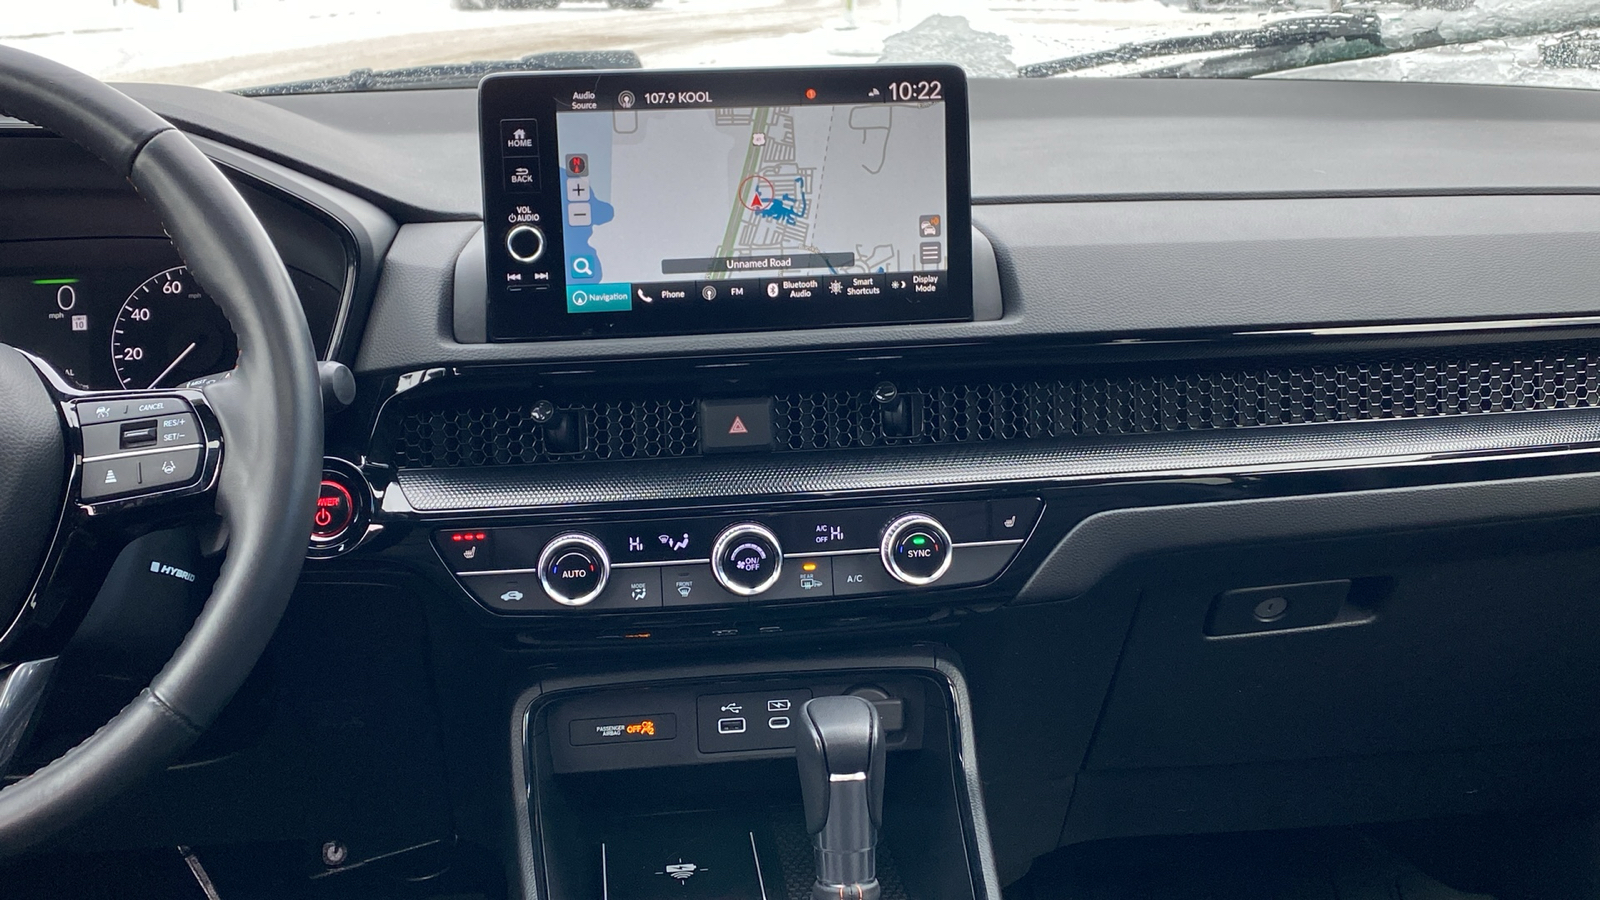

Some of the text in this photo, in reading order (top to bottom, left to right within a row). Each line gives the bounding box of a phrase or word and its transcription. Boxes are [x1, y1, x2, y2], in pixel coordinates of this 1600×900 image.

[888, 81, 942, 100] 10:22
[572, 91, 596, 100] Audio
[644, 91, 713, 104] 107.9 KOOL
[571, 101, 597, 110] Source
[507, 138, 533, 147] HOME
[511, 174, 533, 183] BACK
[516, 205, 532, 214] VOL
[516, 213, 540, 222] AUDIO
[726, 257, 792, 269] Unnamed Road
[852, 277, 874, 286] Smart
[912, 274, 939, 284] Display
[162, 281, 182, 294] 60
[782, 280, 818, 290] Bluetooth
[915, 284, 937, 293] Mode
[661, 290, 686, 299] Phone
[730, 287, 744, 296] FM
[789, 290, 812, 299] Audio
[846, 286, 880, 296] Shortcuts
[57, 284, 76, 311] 0
[589, 292, 628, 303] Navigation
[48, 311, 65, 320] mph
[130, 307, 150, 321] 40
[75, 321, 84, 329] 10
[124, 347, 143, 361] 20
[138, 402, 165, 412] CANCEL
[163, 418, 186, 428] RES/+
[815, 525, 828, 533] A/C
[815, 536, 828, 544] OFF
[907, 549, 932, 558] SYNC
[745, 557, 760, 565] ON/
[160, 564, 196, 583] HYBRID
[561, 569, 587, 579] AUTO
[846, 574, 863, 583] A/C
[626, 725, 642, 734] OFF
